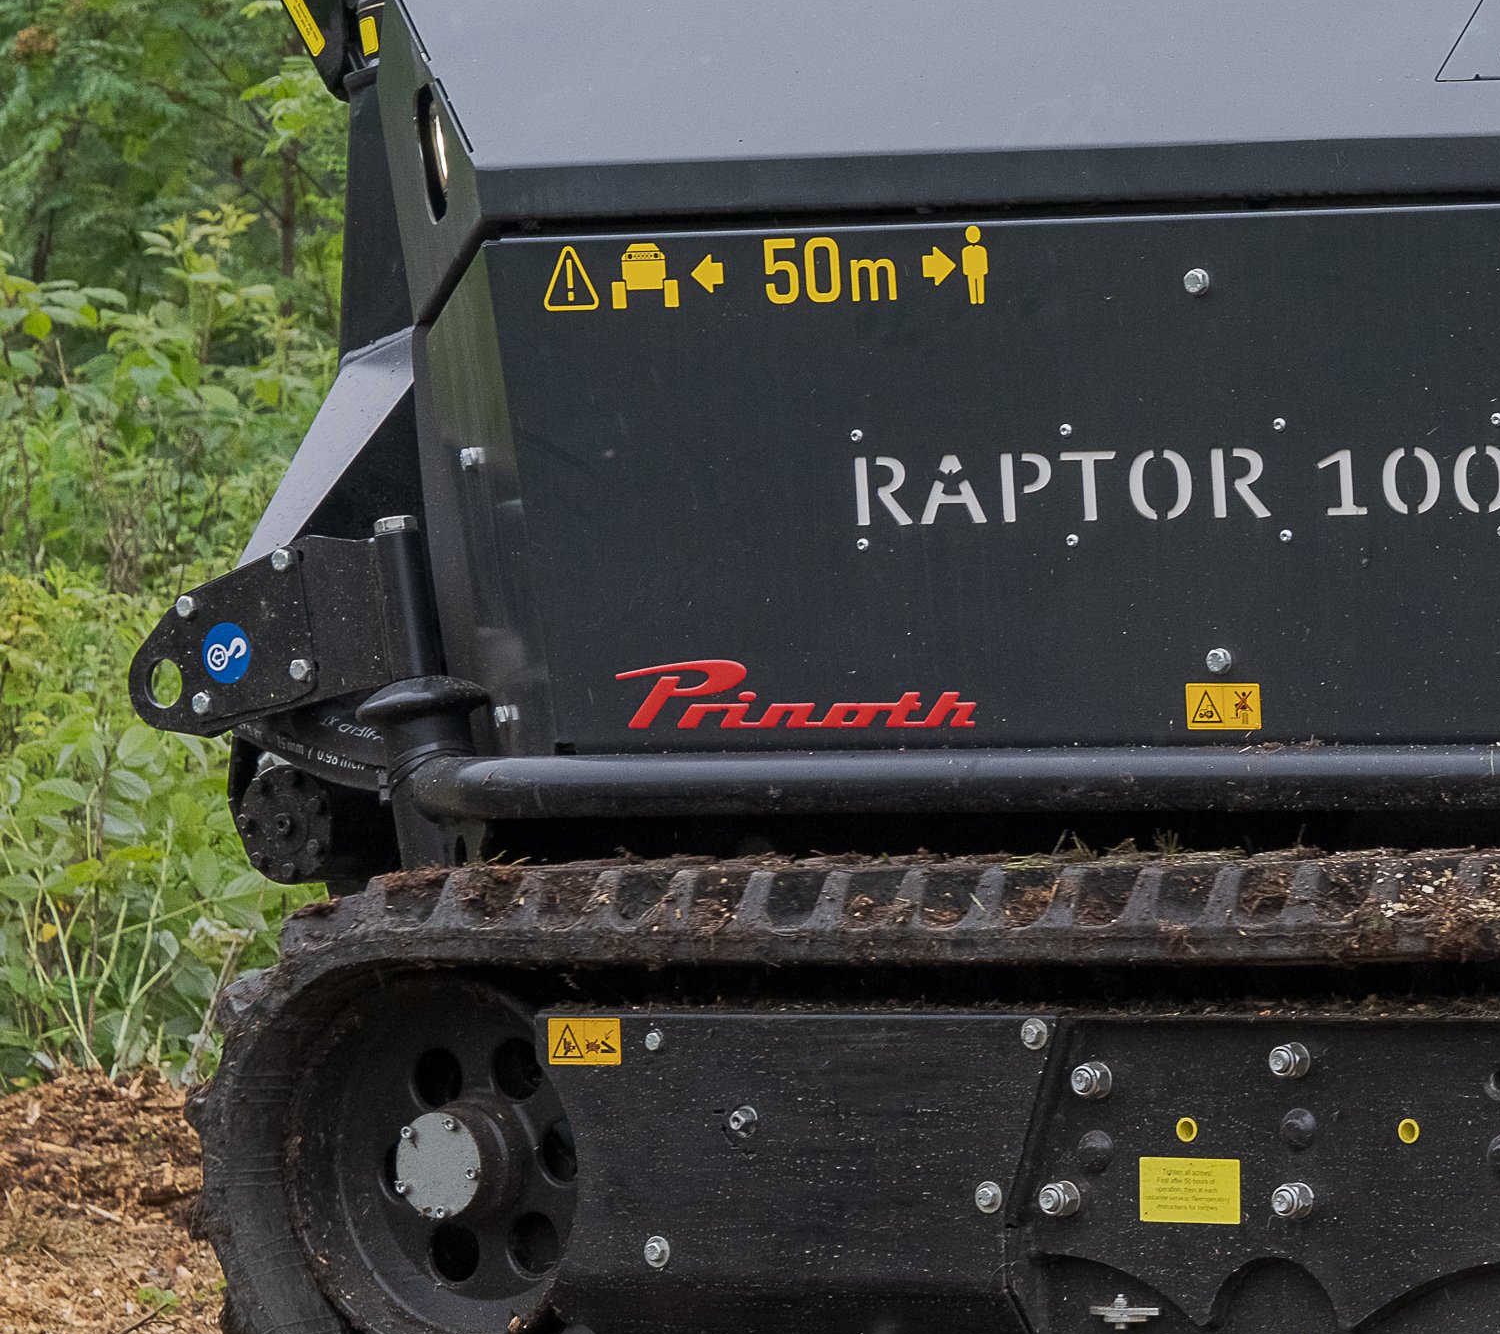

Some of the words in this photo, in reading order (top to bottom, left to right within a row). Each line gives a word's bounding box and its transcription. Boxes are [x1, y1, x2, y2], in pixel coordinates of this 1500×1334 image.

[763, 236, 898, 305] 50m
[854, 448, 1272, 526] RAPTOR
[615, 661, 977, 729] Prinoth
